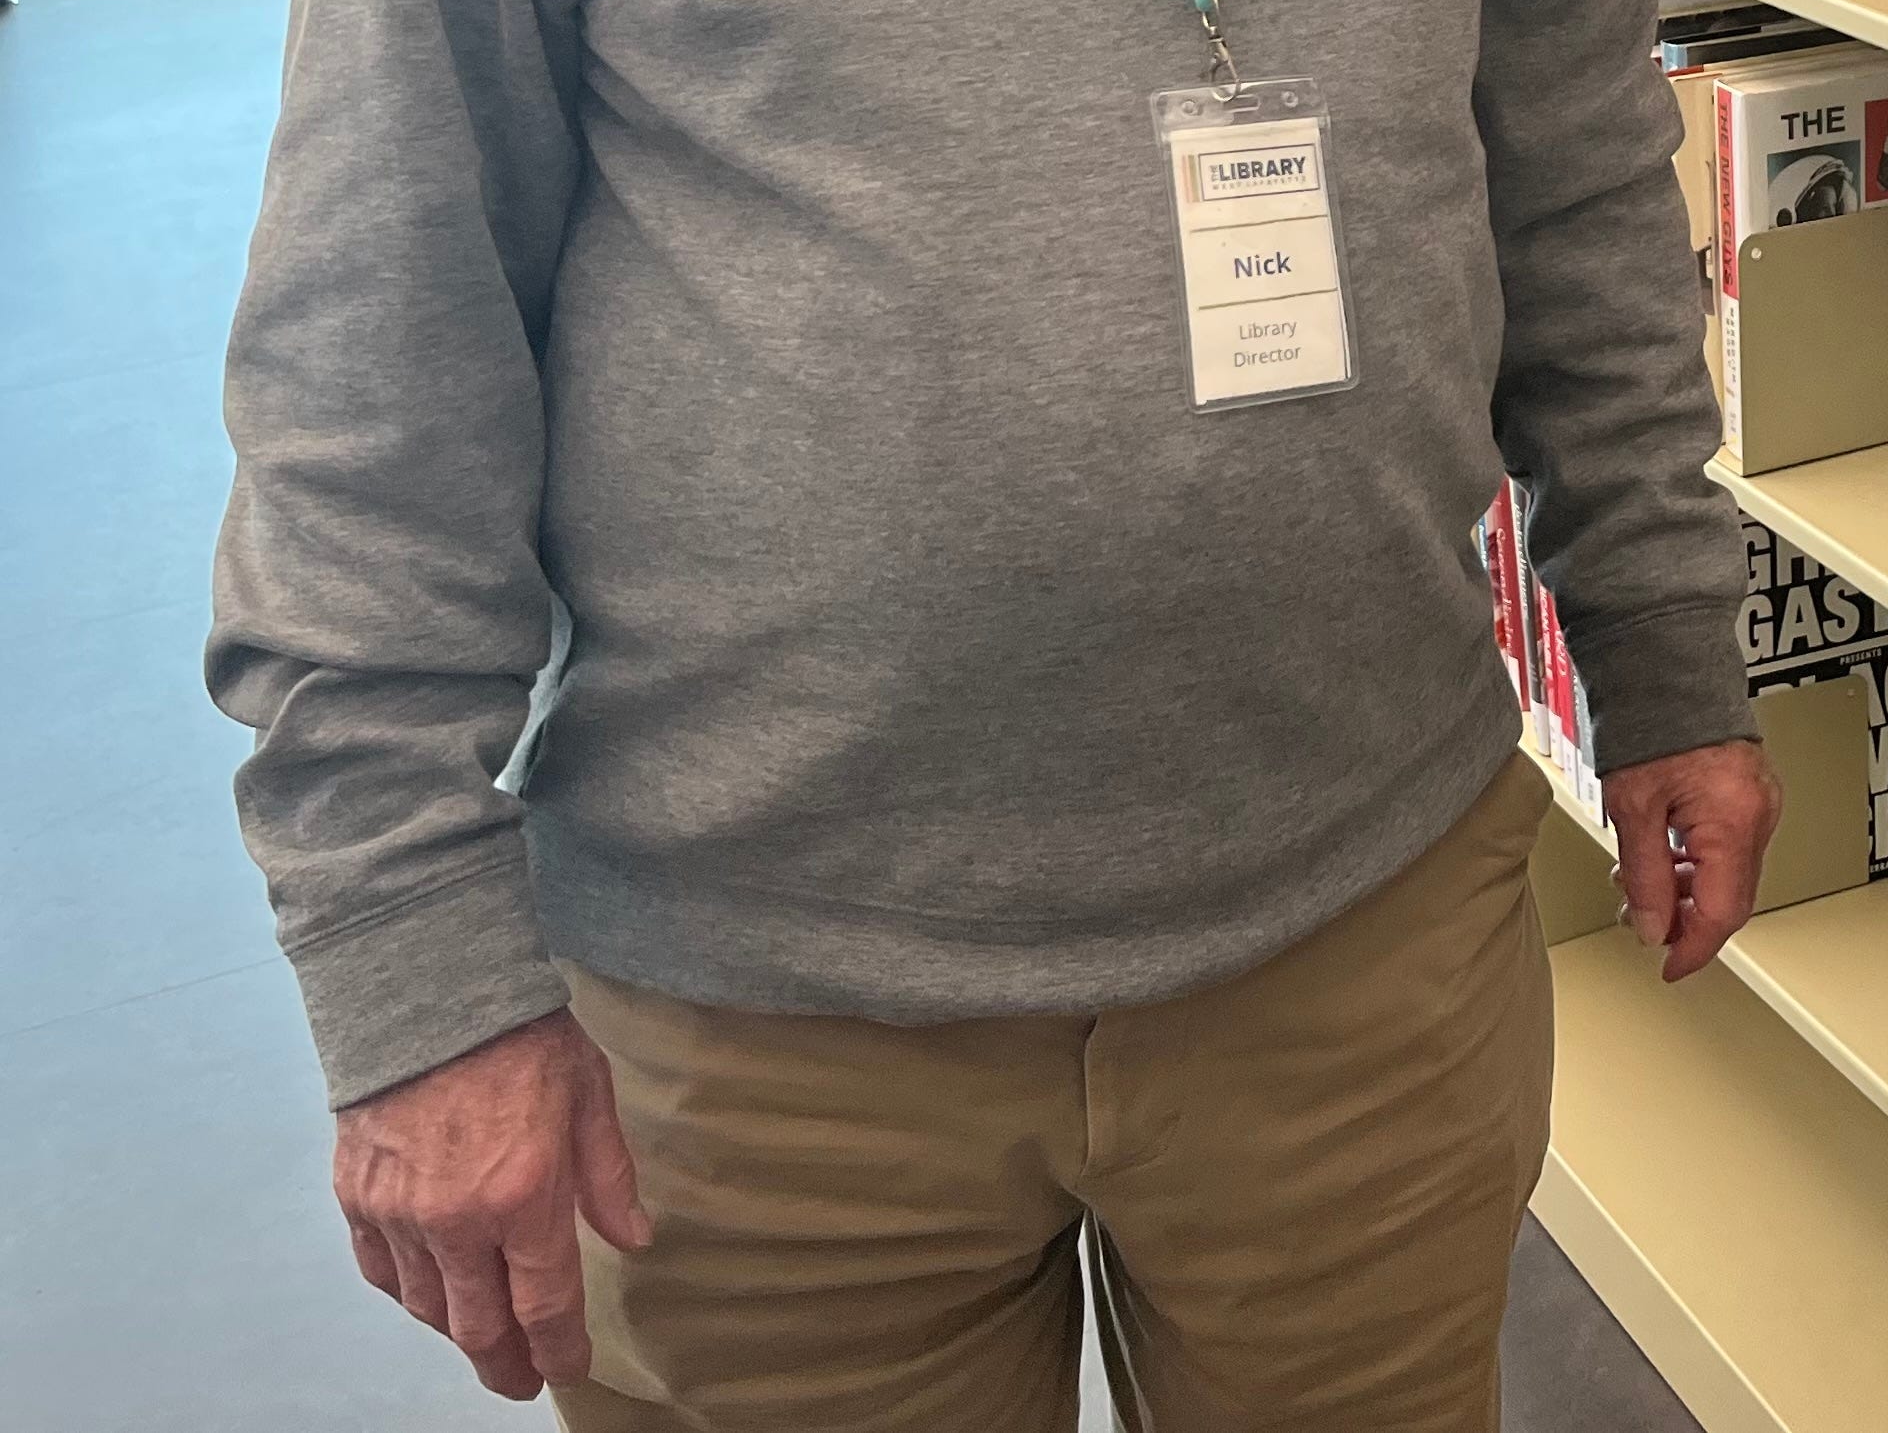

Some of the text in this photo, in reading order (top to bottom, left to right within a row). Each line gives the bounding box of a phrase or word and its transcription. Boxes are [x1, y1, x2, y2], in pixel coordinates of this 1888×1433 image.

[1781, 106, 1846, 140] THE
[1219, 156, 1306, 181] LIBRARY
[1234, 252, 1292, 279] Nick
[1239, 321, 1297, 341] Library
[1234, 346, 1301, 367] Director
